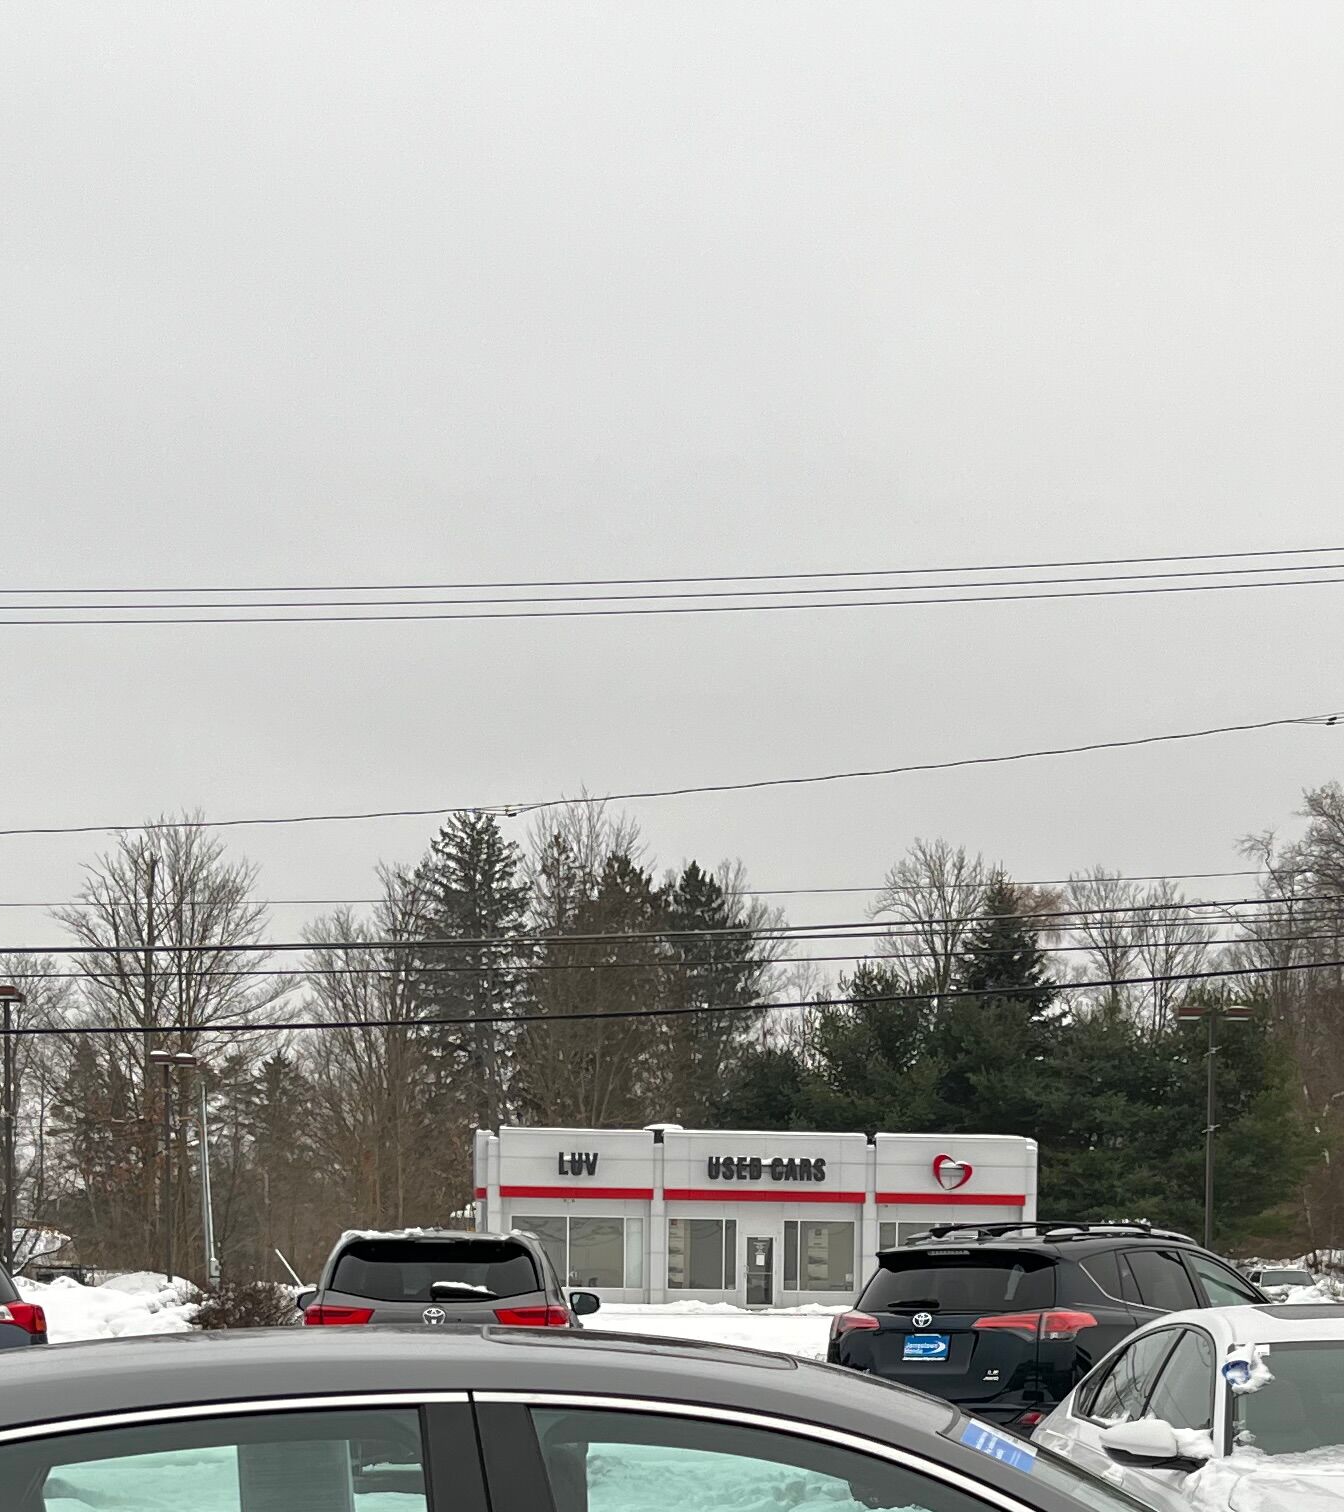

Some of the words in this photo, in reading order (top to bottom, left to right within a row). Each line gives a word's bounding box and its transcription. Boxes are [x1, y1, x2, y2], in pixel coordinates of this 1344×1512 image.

[558, 1152, 598, 1176] LUV
[708, 1156, 762, 1180] USED
[771, 1157, 827, 1182] CARS
